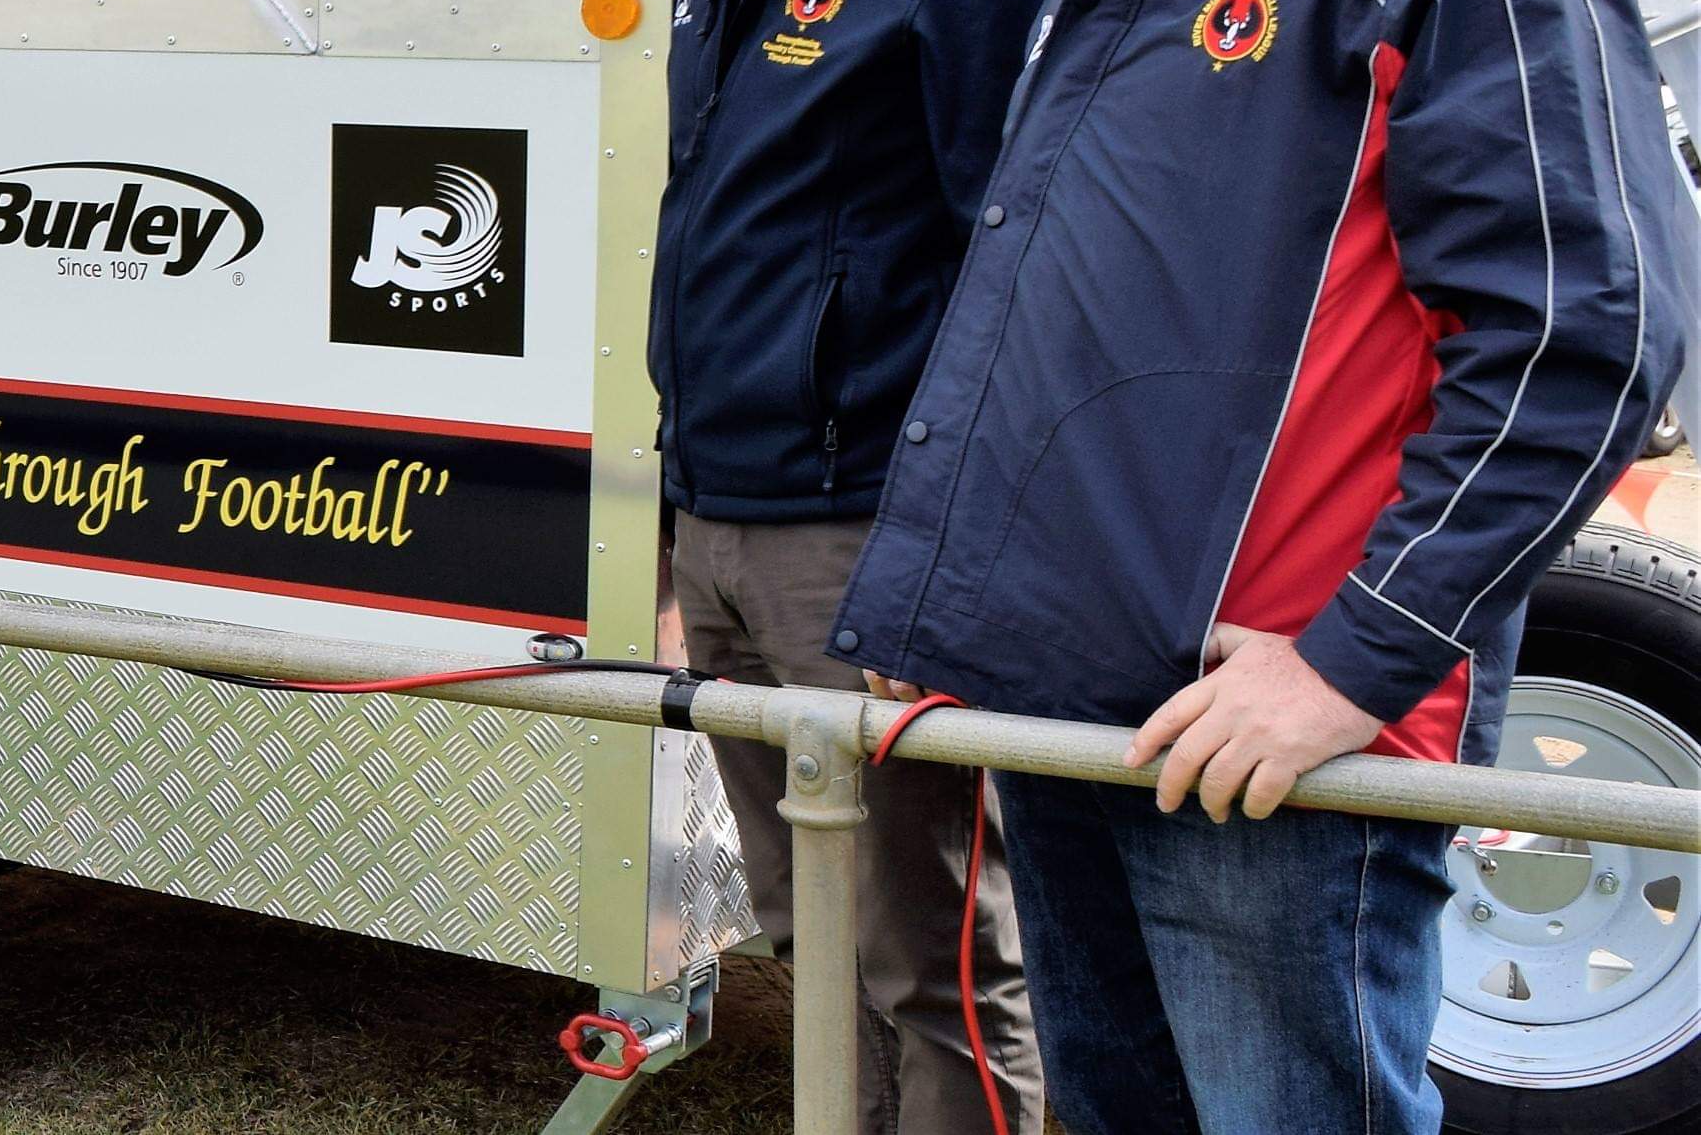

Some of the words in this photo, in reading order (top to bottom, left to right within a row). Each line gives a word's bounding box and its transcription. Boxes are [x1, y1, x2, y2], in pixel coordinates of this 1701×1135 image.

[57, 257, 102, 278] Since
[110, 261, 148, 280] 1907
[389, 268, 505, 312] SPORTS
[177, 456, 450, 547] Football"
